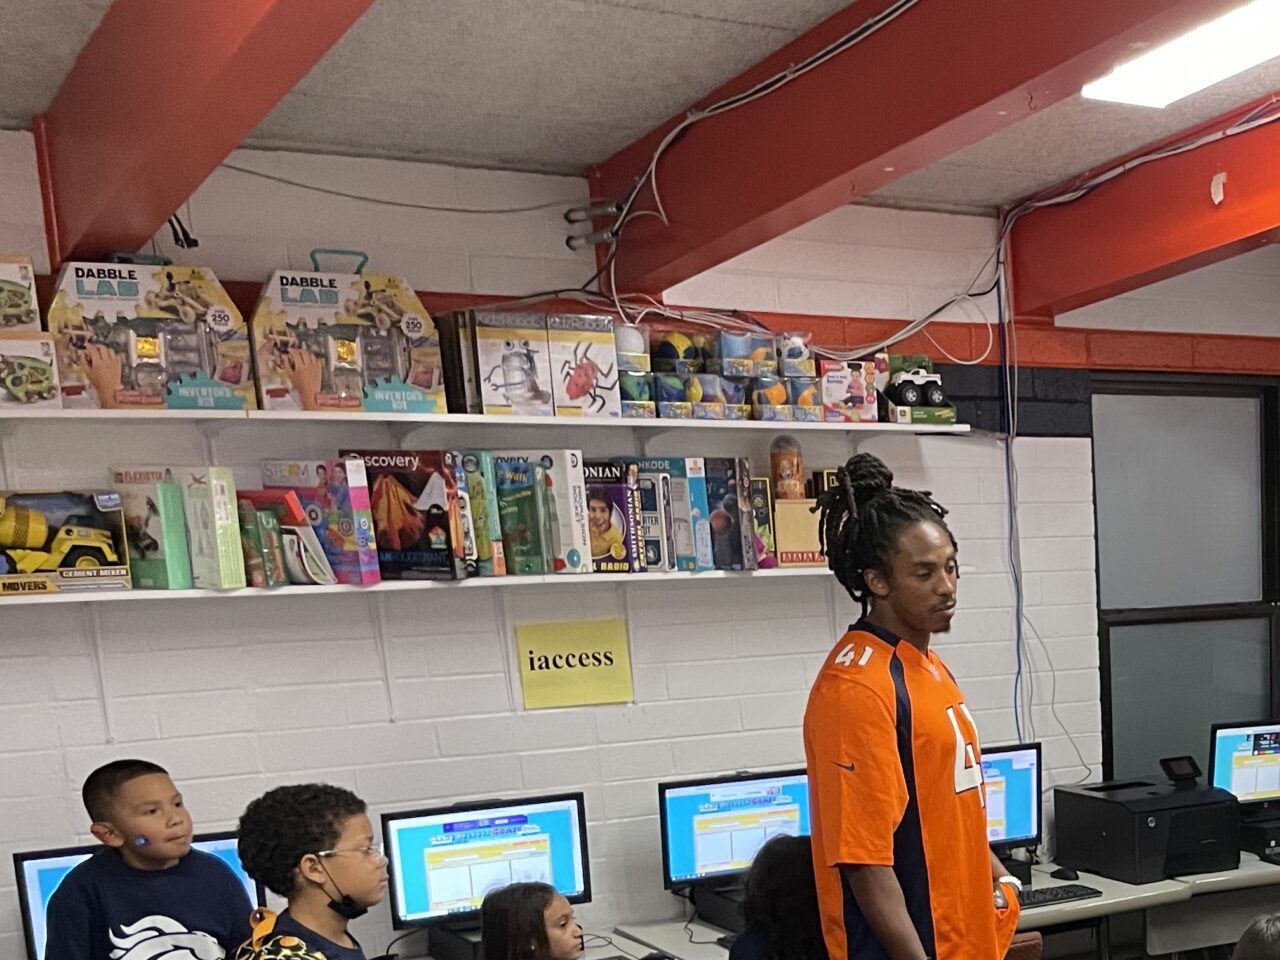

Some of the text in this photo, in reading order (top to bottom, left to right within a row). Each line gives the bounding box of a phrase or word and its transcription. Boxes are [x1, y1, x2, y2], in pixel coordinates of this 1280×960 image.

[75, 267, 137, 280] DABBLE
[76, 279, 139, 297] LAB
[280, 276, 337, 289] DABBLE
[280, 288, 339, 305] LAB
[211, 313, 230, 322] 250
[405, 321, 422, 330] 250
[626, 489, 638, 559] SMITHSONIAN
[601, 562, 630, 571] RADIO
[2, 581, 47, 592] MOVERS
[528, 650, 614, 671] iaccess
[834, 643, 874, 667] 41
